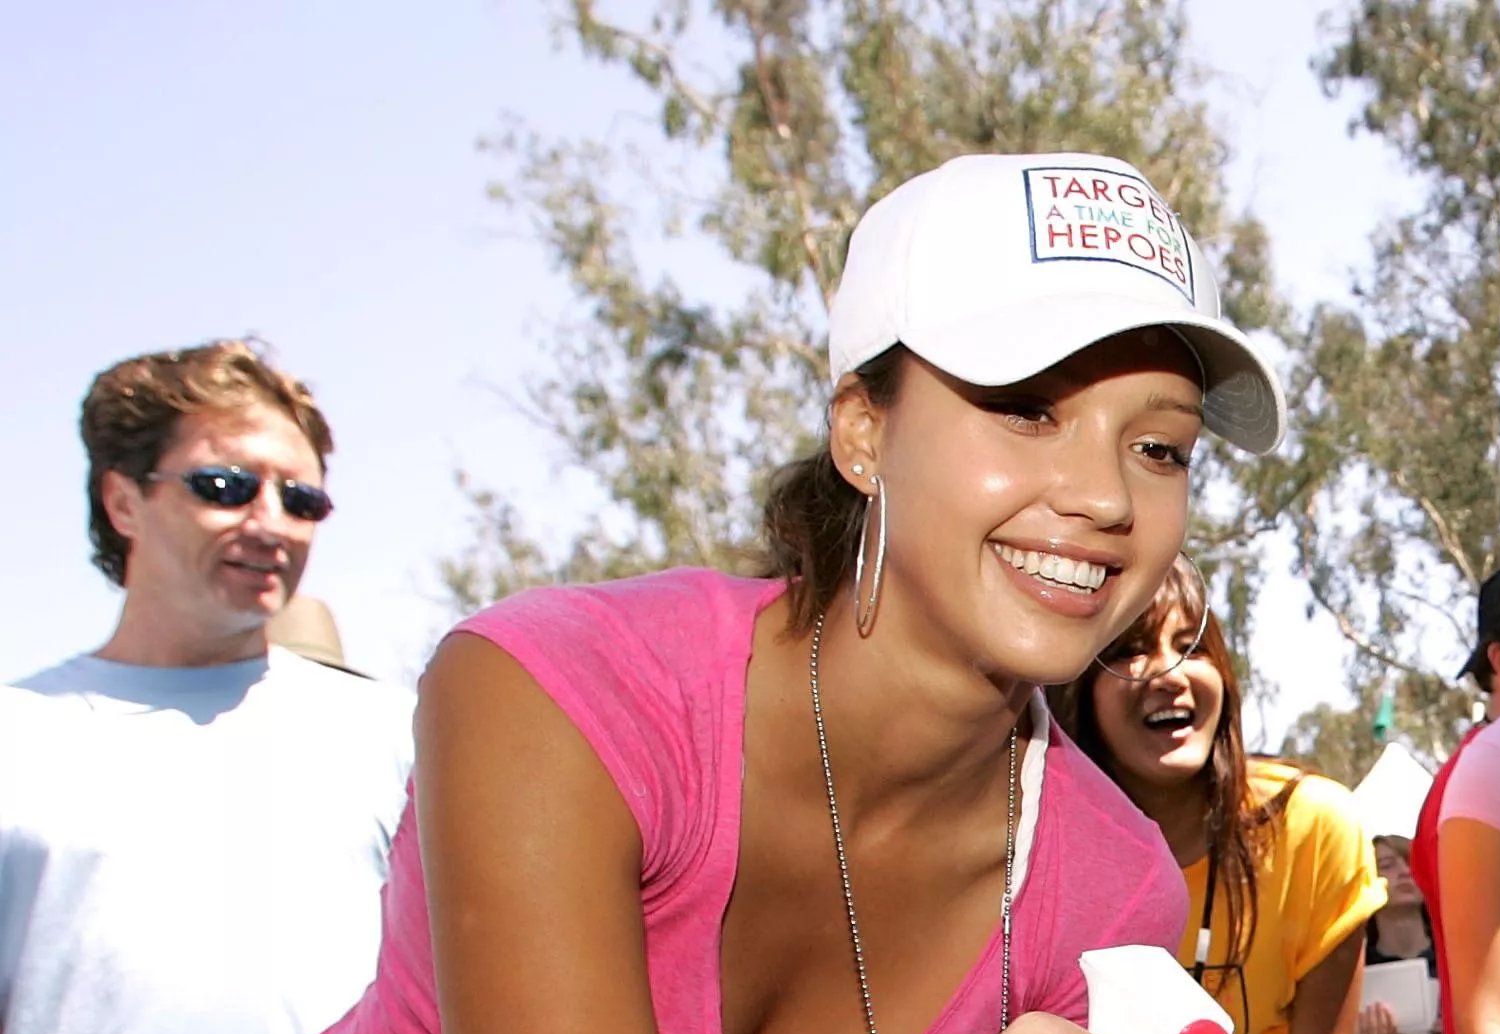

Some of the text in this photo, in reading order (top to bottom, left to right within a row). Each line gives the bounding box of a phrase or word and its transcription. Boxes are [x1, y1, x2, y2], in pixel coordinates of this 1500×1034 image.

[1042, 175, 1175, 233] TARGET
[1046, 204, 1182, 254] A TIME FOR
